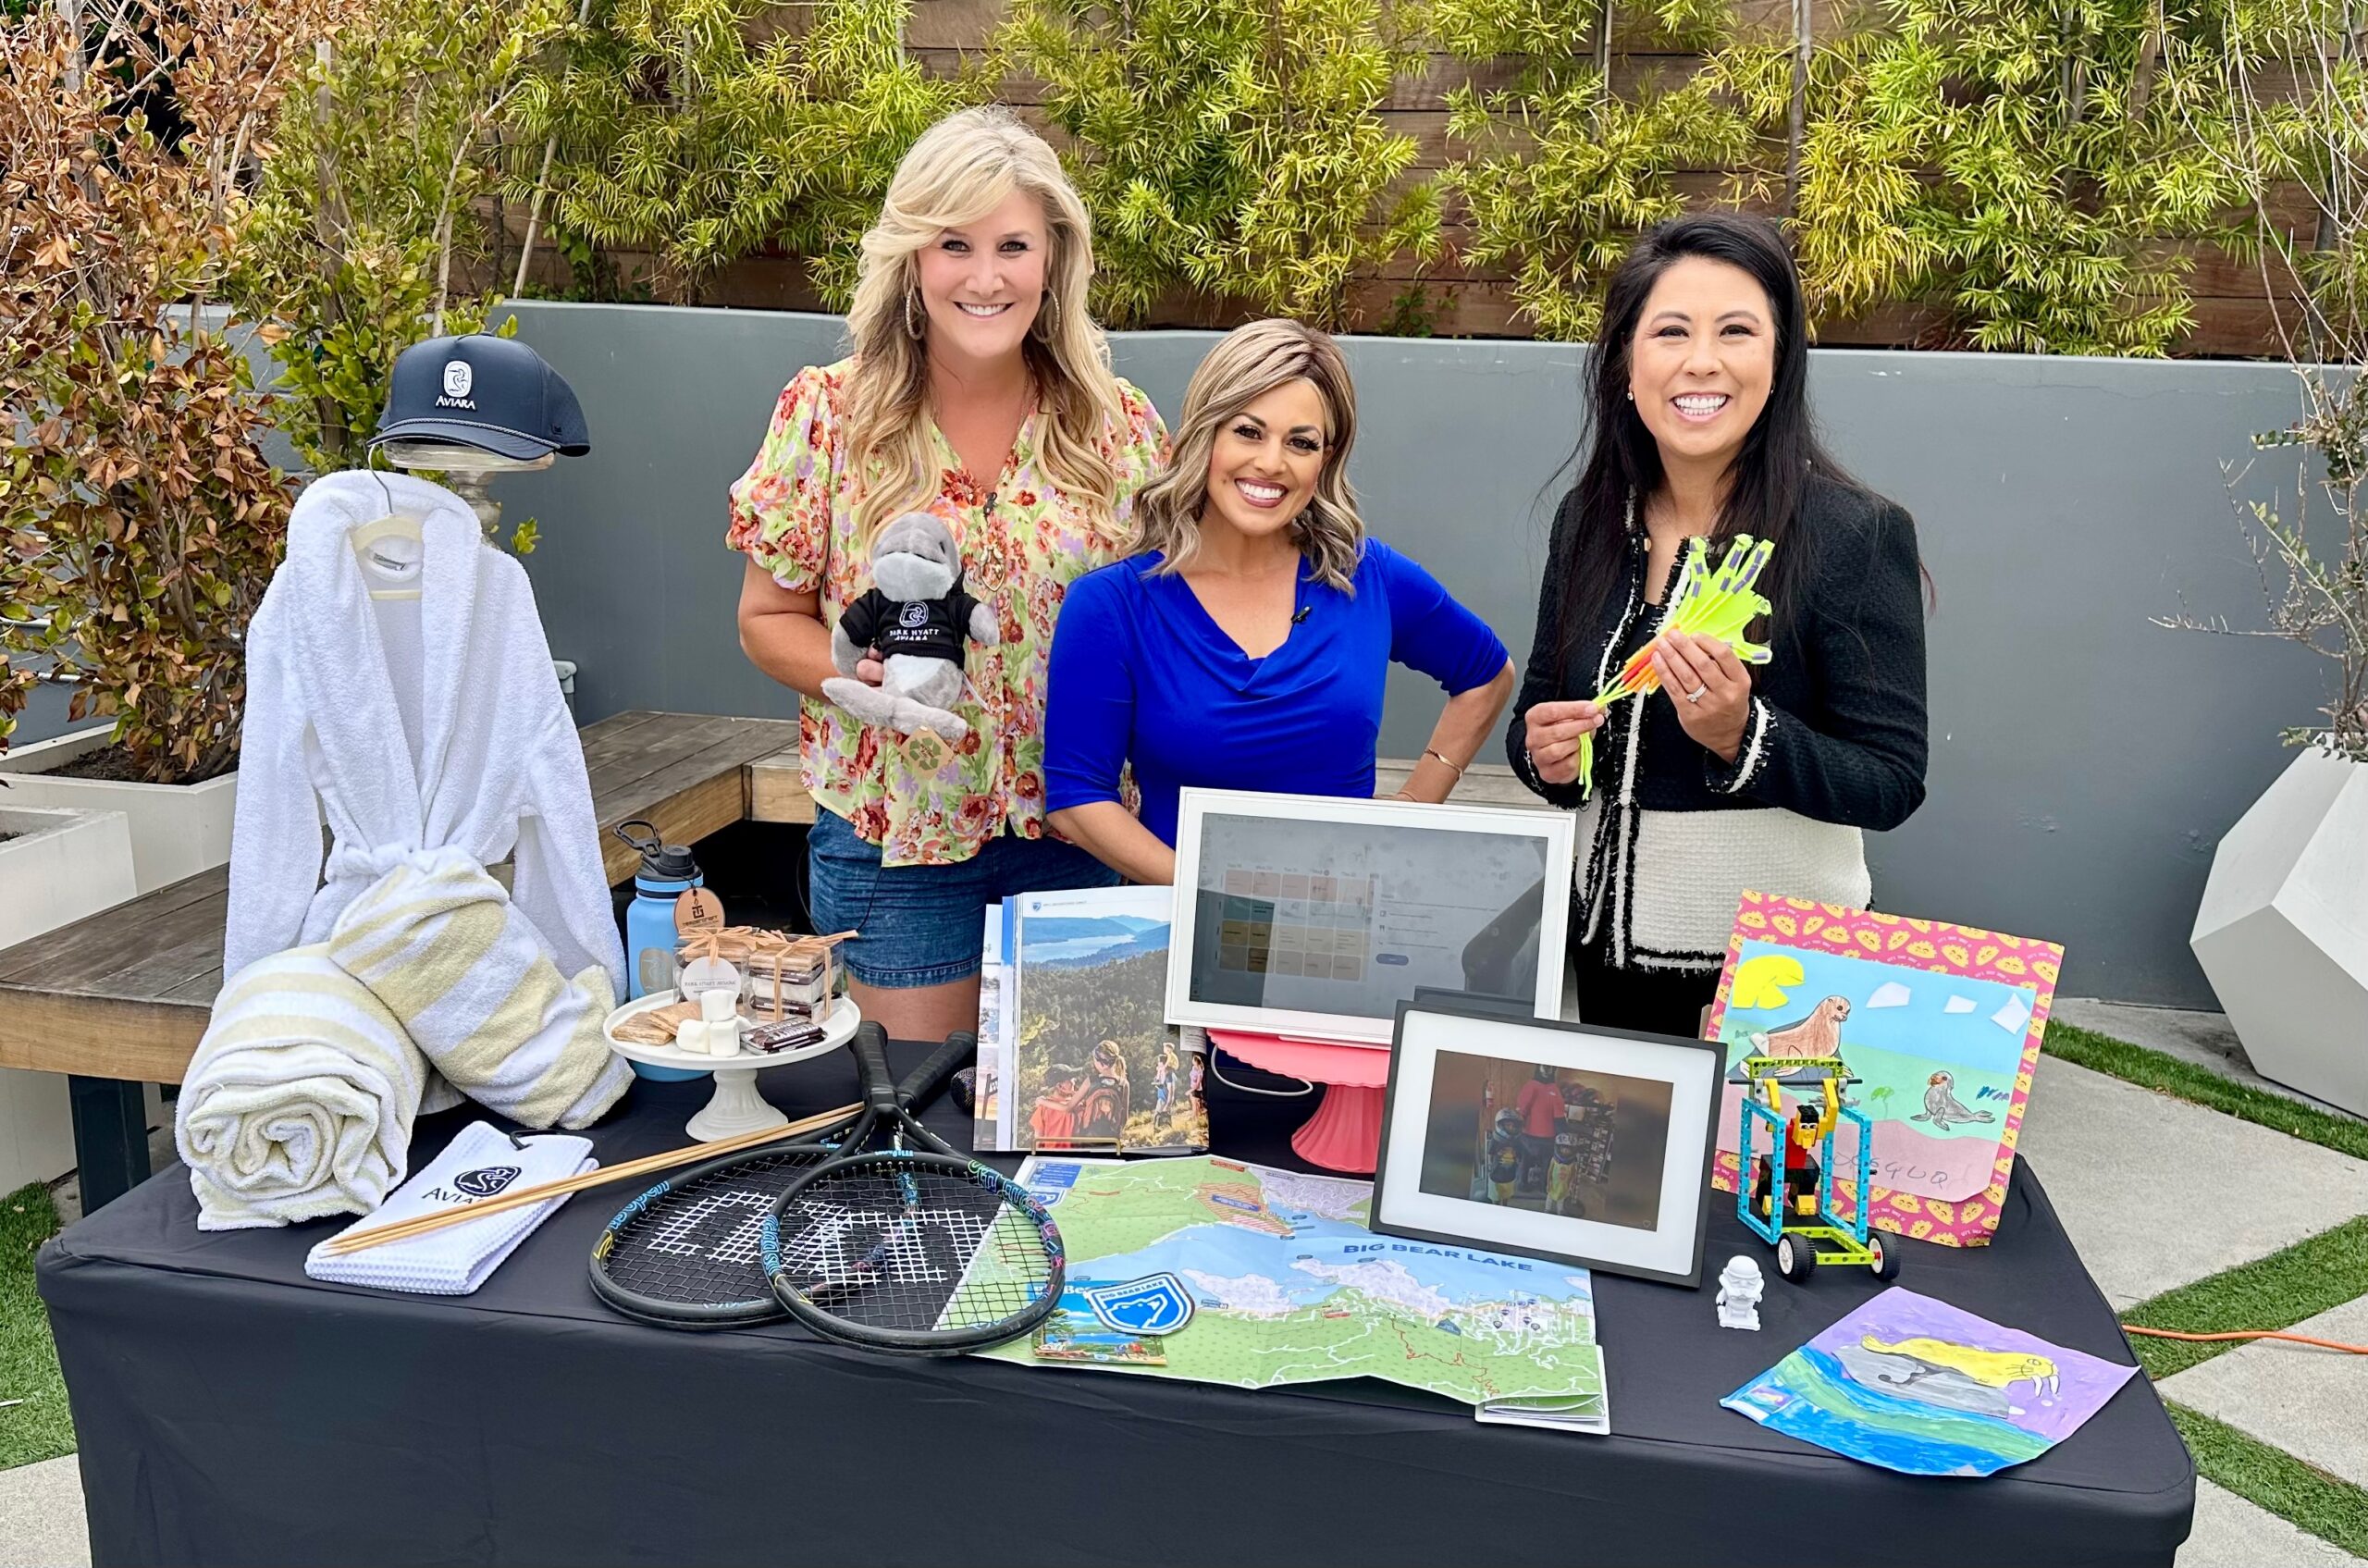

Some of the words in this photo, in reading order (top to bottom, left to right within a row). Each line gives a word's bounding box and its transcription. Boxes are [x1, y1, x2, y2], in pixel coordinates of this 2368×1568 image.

[435, 395, 476, 410] AVIARA
[1343, 1243, 1385, 1253] BIG
[1391, 1243, 1461, 1259] BEAR
[1467, 1253, 1533, 1272] LAKE
[1116, 1287, 1141, 1296] BEAR
[1141, 1280, 1164, 1290] LAKE
